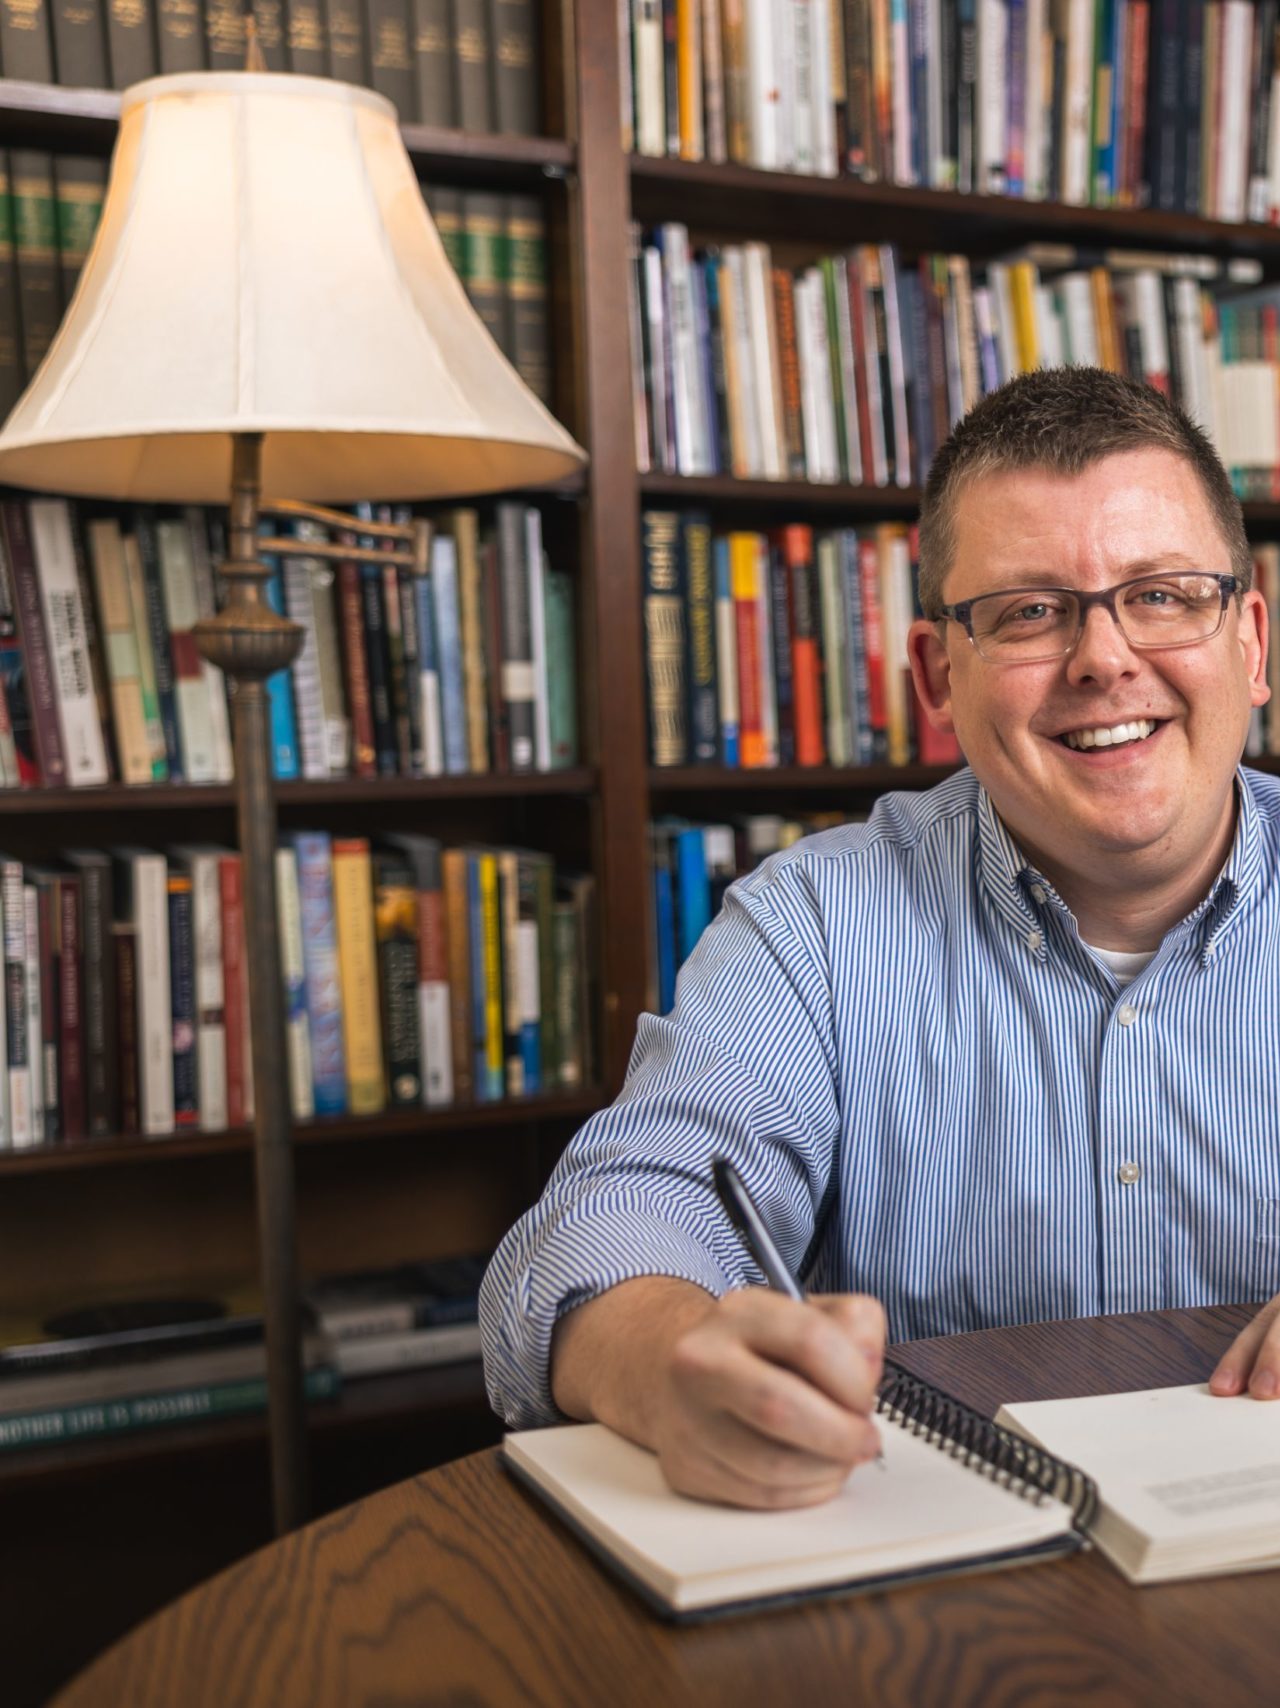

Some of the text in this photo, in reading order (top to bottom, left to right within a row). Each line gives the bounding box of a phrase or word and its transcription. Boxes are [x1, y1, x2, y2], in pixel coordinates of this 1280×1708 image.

[0, 1412, 65, 1445] NOTHER
[69, 1409, 104, 1434] LIFE
[136, 1391, 210, 1421] POSSIBLE
